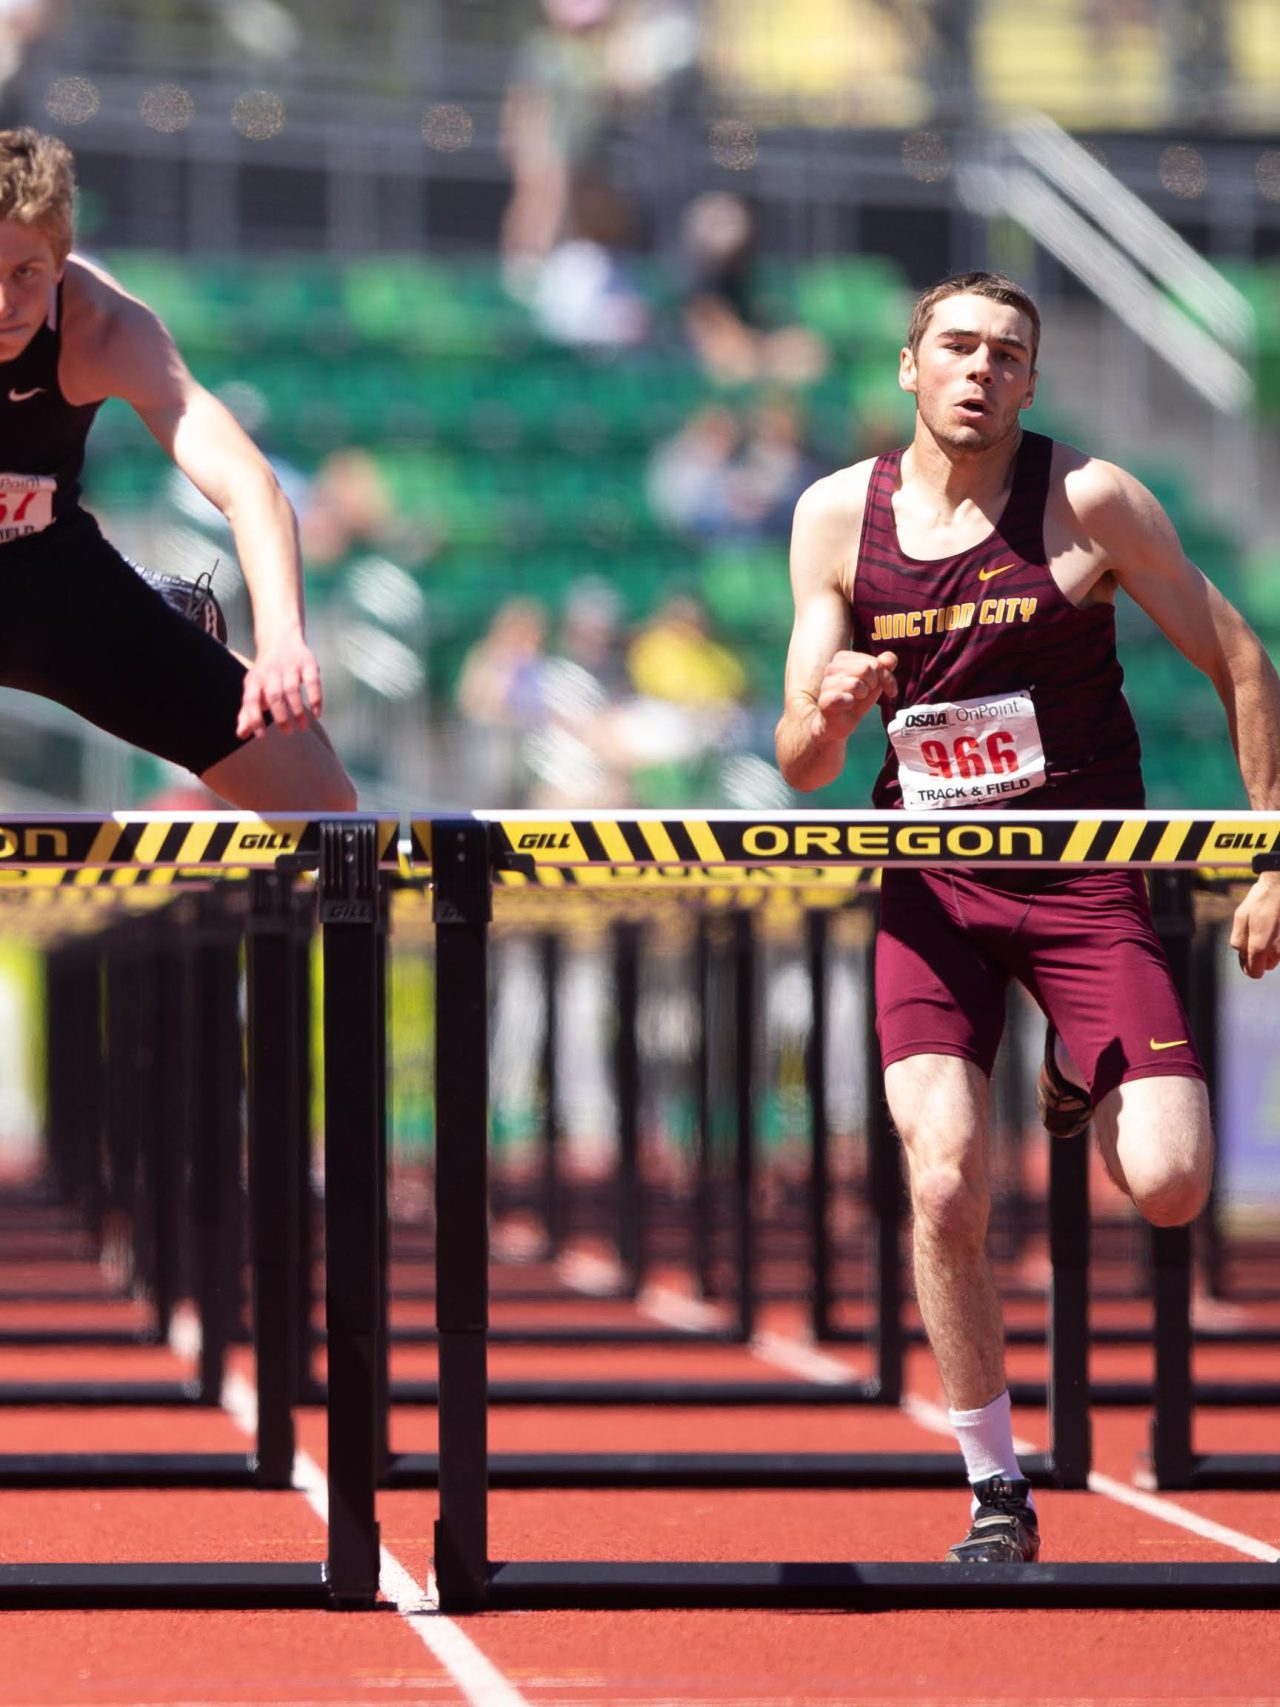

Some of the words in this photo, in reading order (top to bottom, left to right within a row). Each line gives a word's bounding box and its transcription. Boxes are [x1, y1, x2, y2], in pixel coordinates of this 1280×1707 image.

[871, 602, 976, 640] JUNCTION
[979, 597, 1038, 625] CITY
[905, 711, 948, 728] OSAA
[956, 699, 1020, 722] OnPoint
[920, 731, 1020, 779] 966
[917, 787, 967, 801] TRACK
[971, 786, 983, 797] &
[986, 778, 1031, 795] FIELD
[239, 833, 292, 850] GILL
[517, 833, 571, 849] GILL
[741, 824, 1043, 857] OREGON
[1214, 833, 1267, 849] GILL
